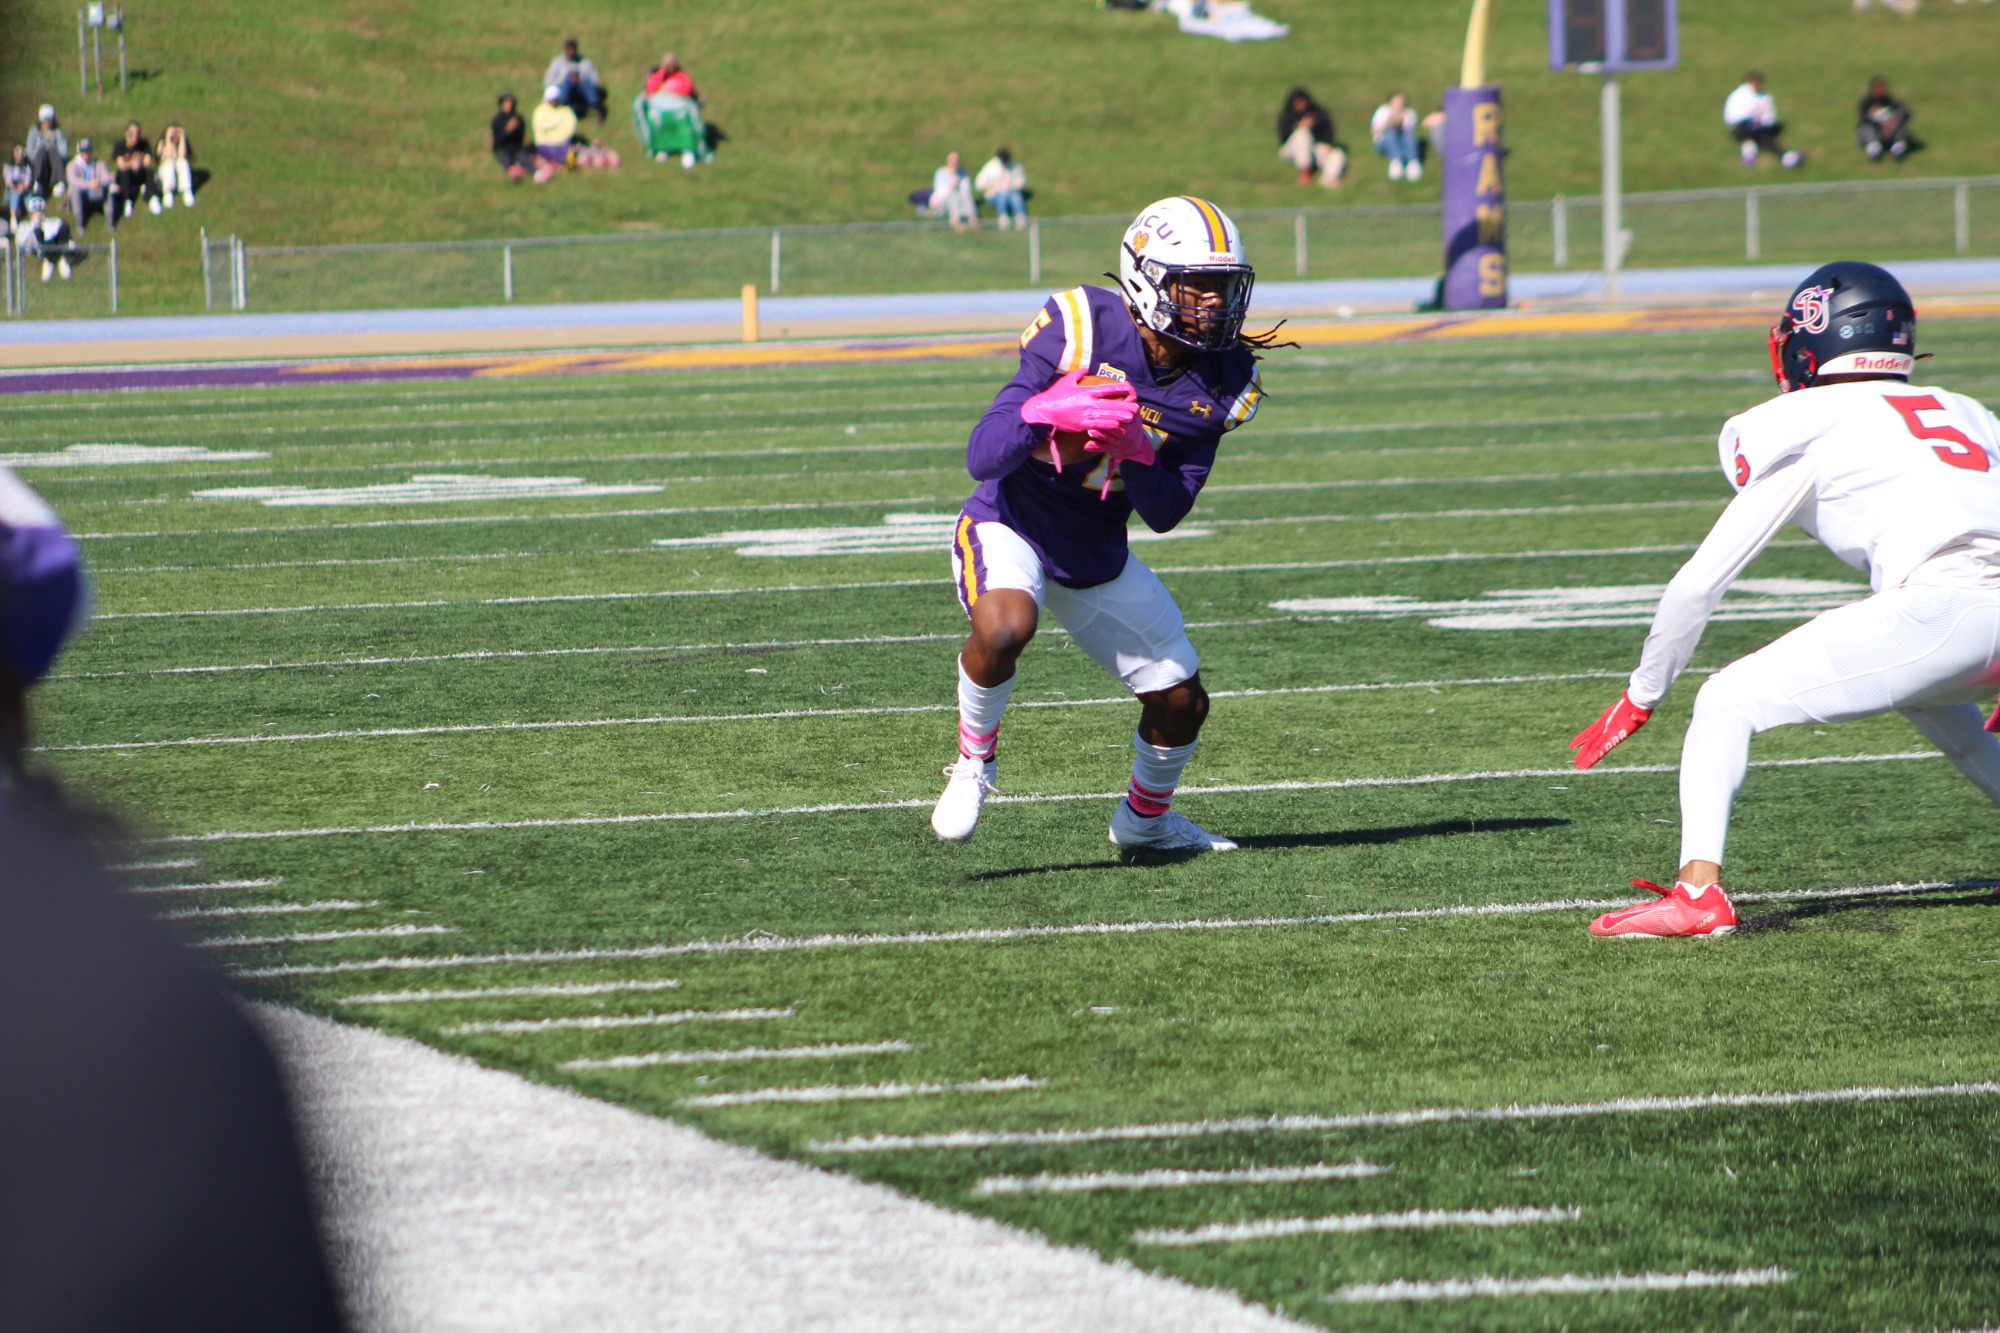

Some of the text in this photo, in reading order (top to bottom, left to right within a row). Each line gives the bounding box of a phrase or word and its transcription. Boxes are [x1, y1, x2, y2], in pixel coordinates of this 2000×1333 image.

[1474, 102, 1505, 297] RAMS
[1209, 255, 1236, 263] Riddell
[1854, 356, 1910, 371] Riddell
[1140, 405, 1162, 424] WCU
[1882, 394, 1989, 473] 5
